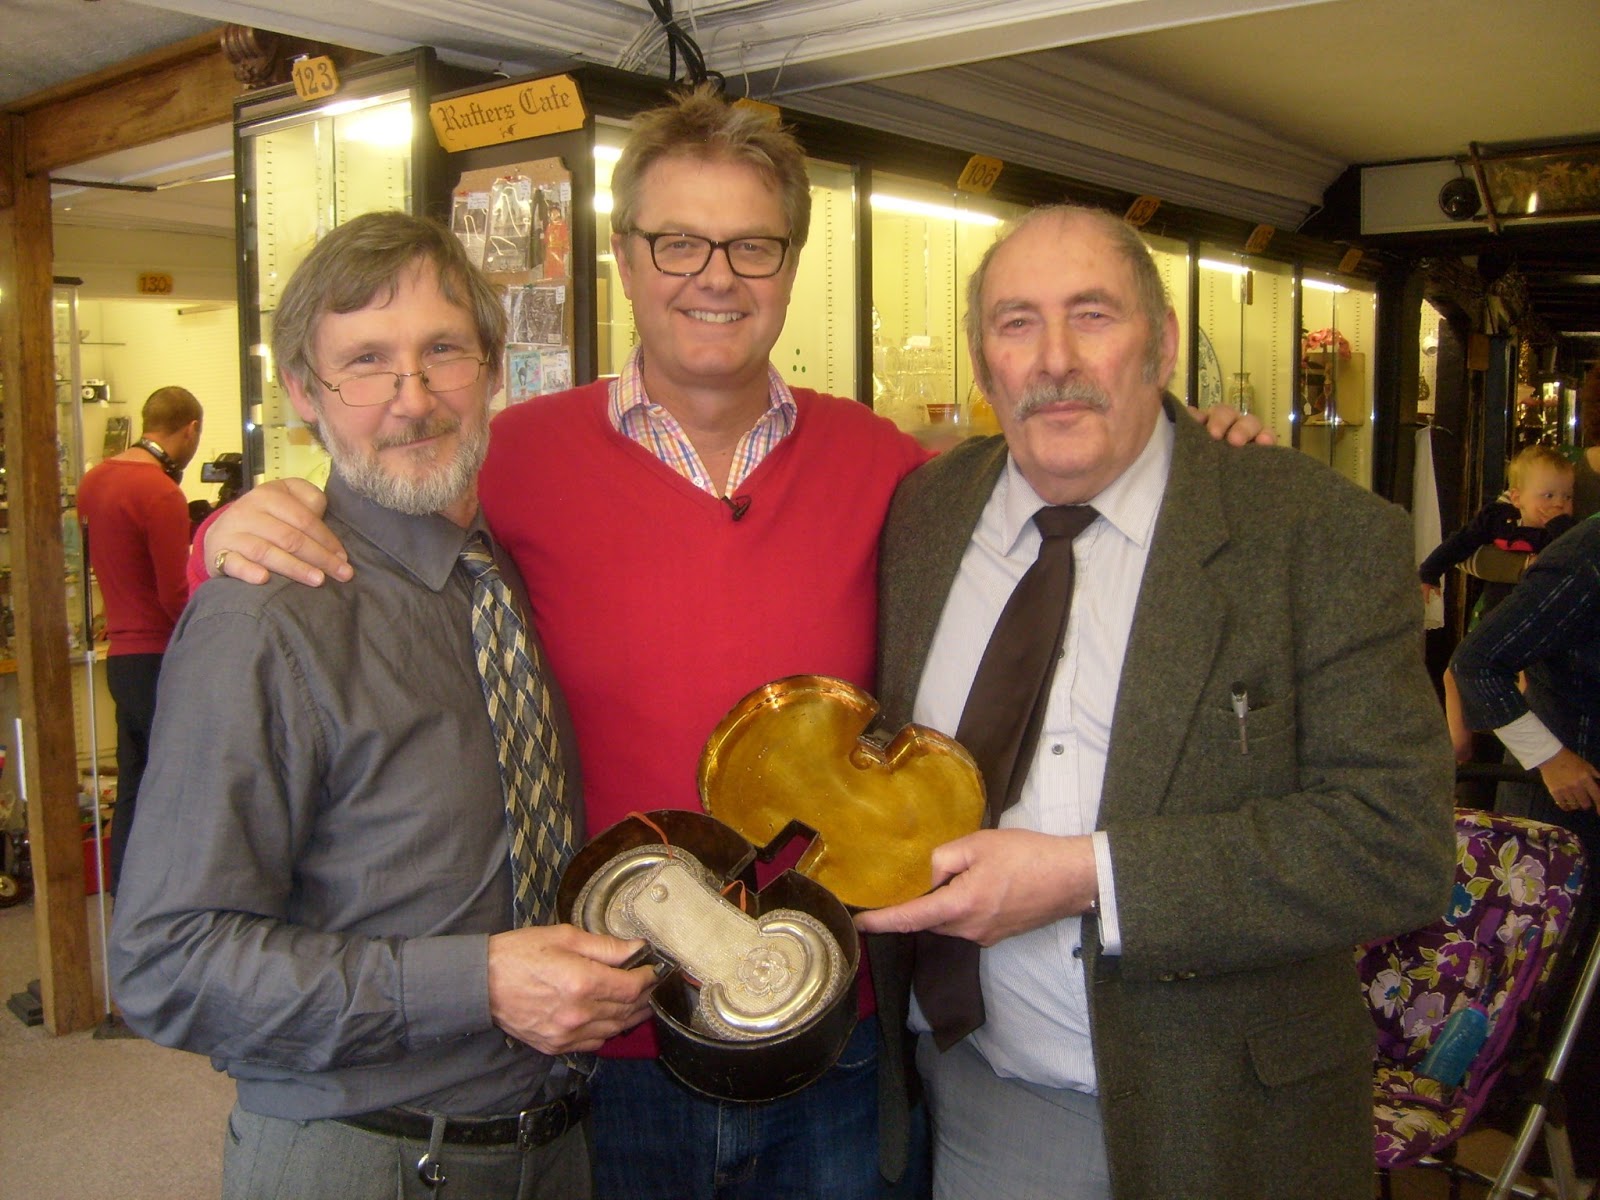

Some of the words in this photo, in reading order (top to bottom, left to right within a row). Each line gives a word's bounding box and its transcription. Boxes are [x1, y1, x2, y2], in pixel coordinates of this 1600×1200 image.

[295, 62, 333, 97] 123
[437, 102, 515, 140] Rafters
[519, 84, 571, 115] Cafe
[966, 162, 998, 188] 106
